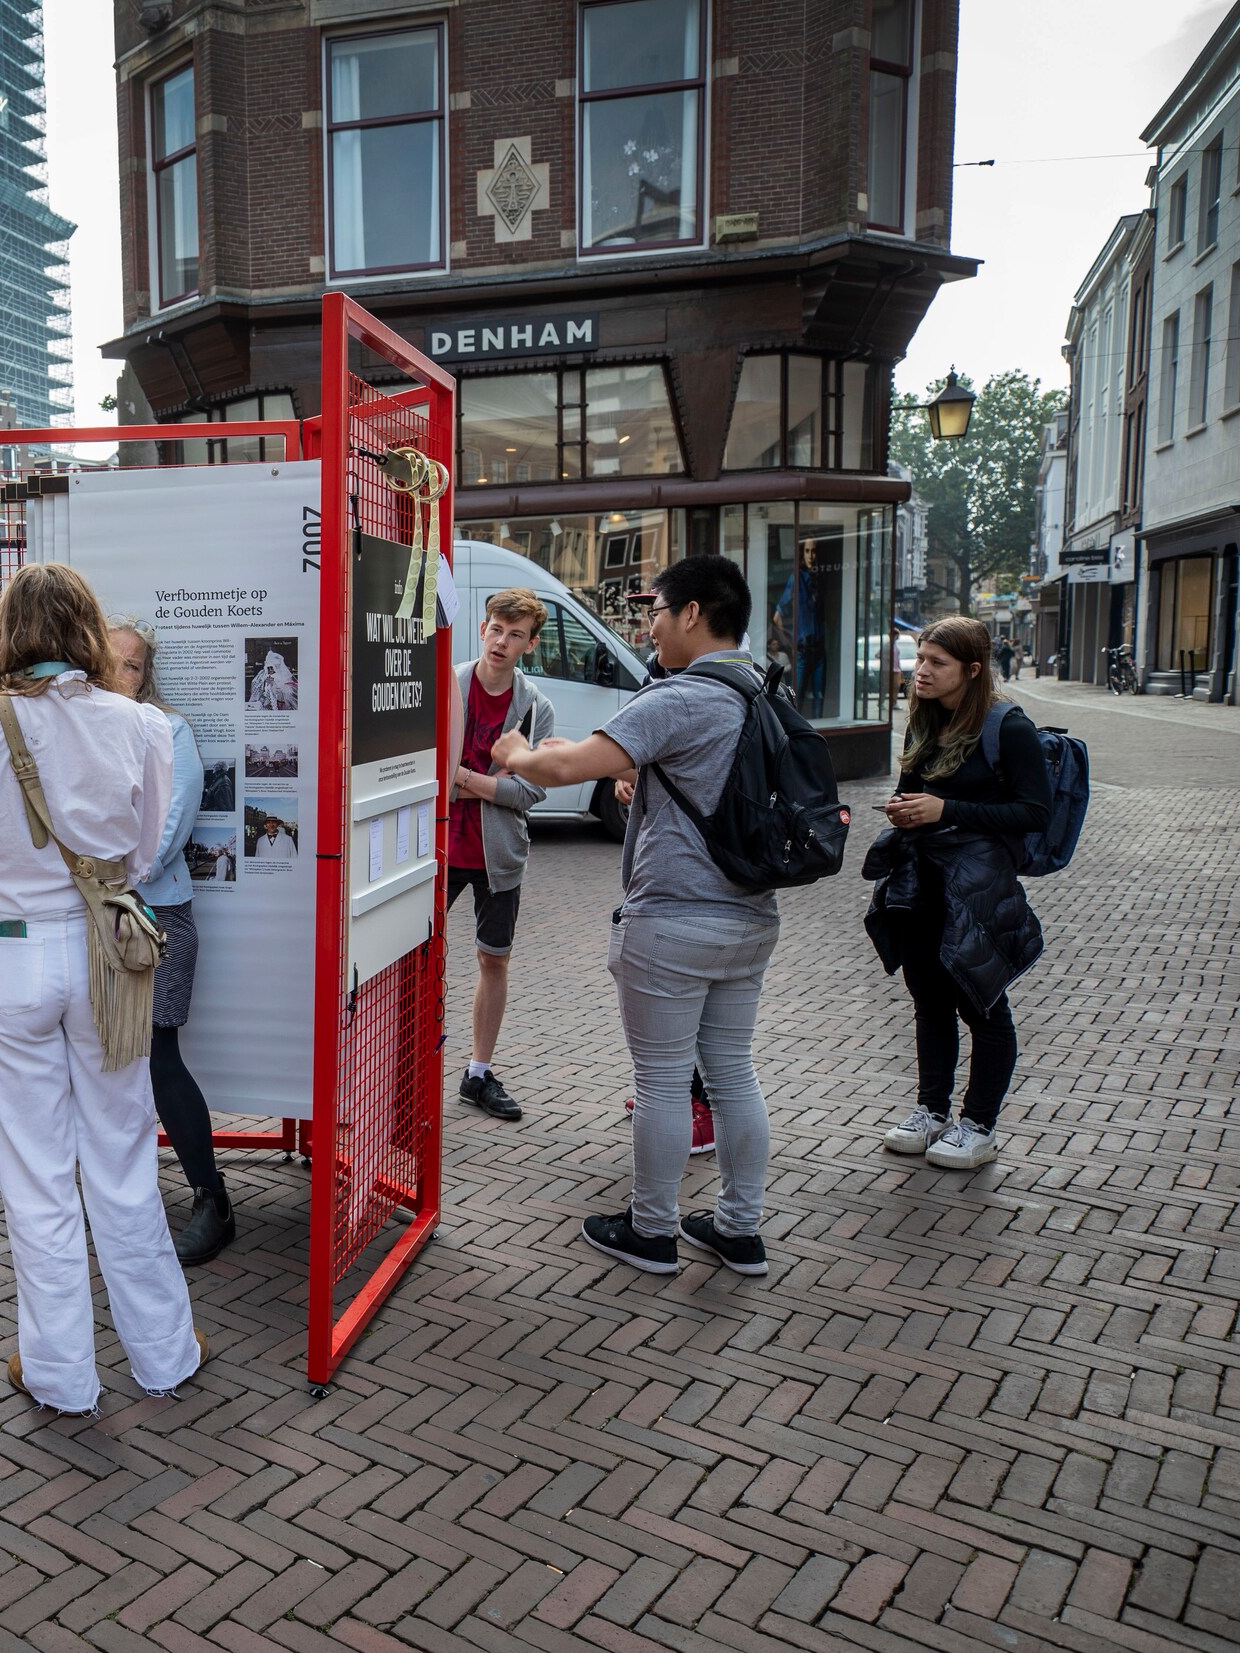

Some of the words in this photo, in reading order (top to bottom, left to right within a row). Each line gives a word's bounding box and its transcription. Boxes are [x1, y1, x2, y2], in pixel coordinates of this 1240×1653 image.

[432, 320, 592, 355] DENHAM
[155, 588, 247, 602] Verfbommetje
[251, 589, 268, 601] op
[155, 606, 170, 618] de
[173, 605, 223, 618] Gouden
[227, 605, 263, 616] Koets
[366, 612, 381, 642] WAT
[382, 614, 394, 643] WIL
[406, 617, 428, 644] WETE
[385, 648, 402, 677] OVER
[403, 649, 412, 676] DE
[372, 682, 399, 712] GOUDEN
[400, 681, 422, 709] KOETS?
